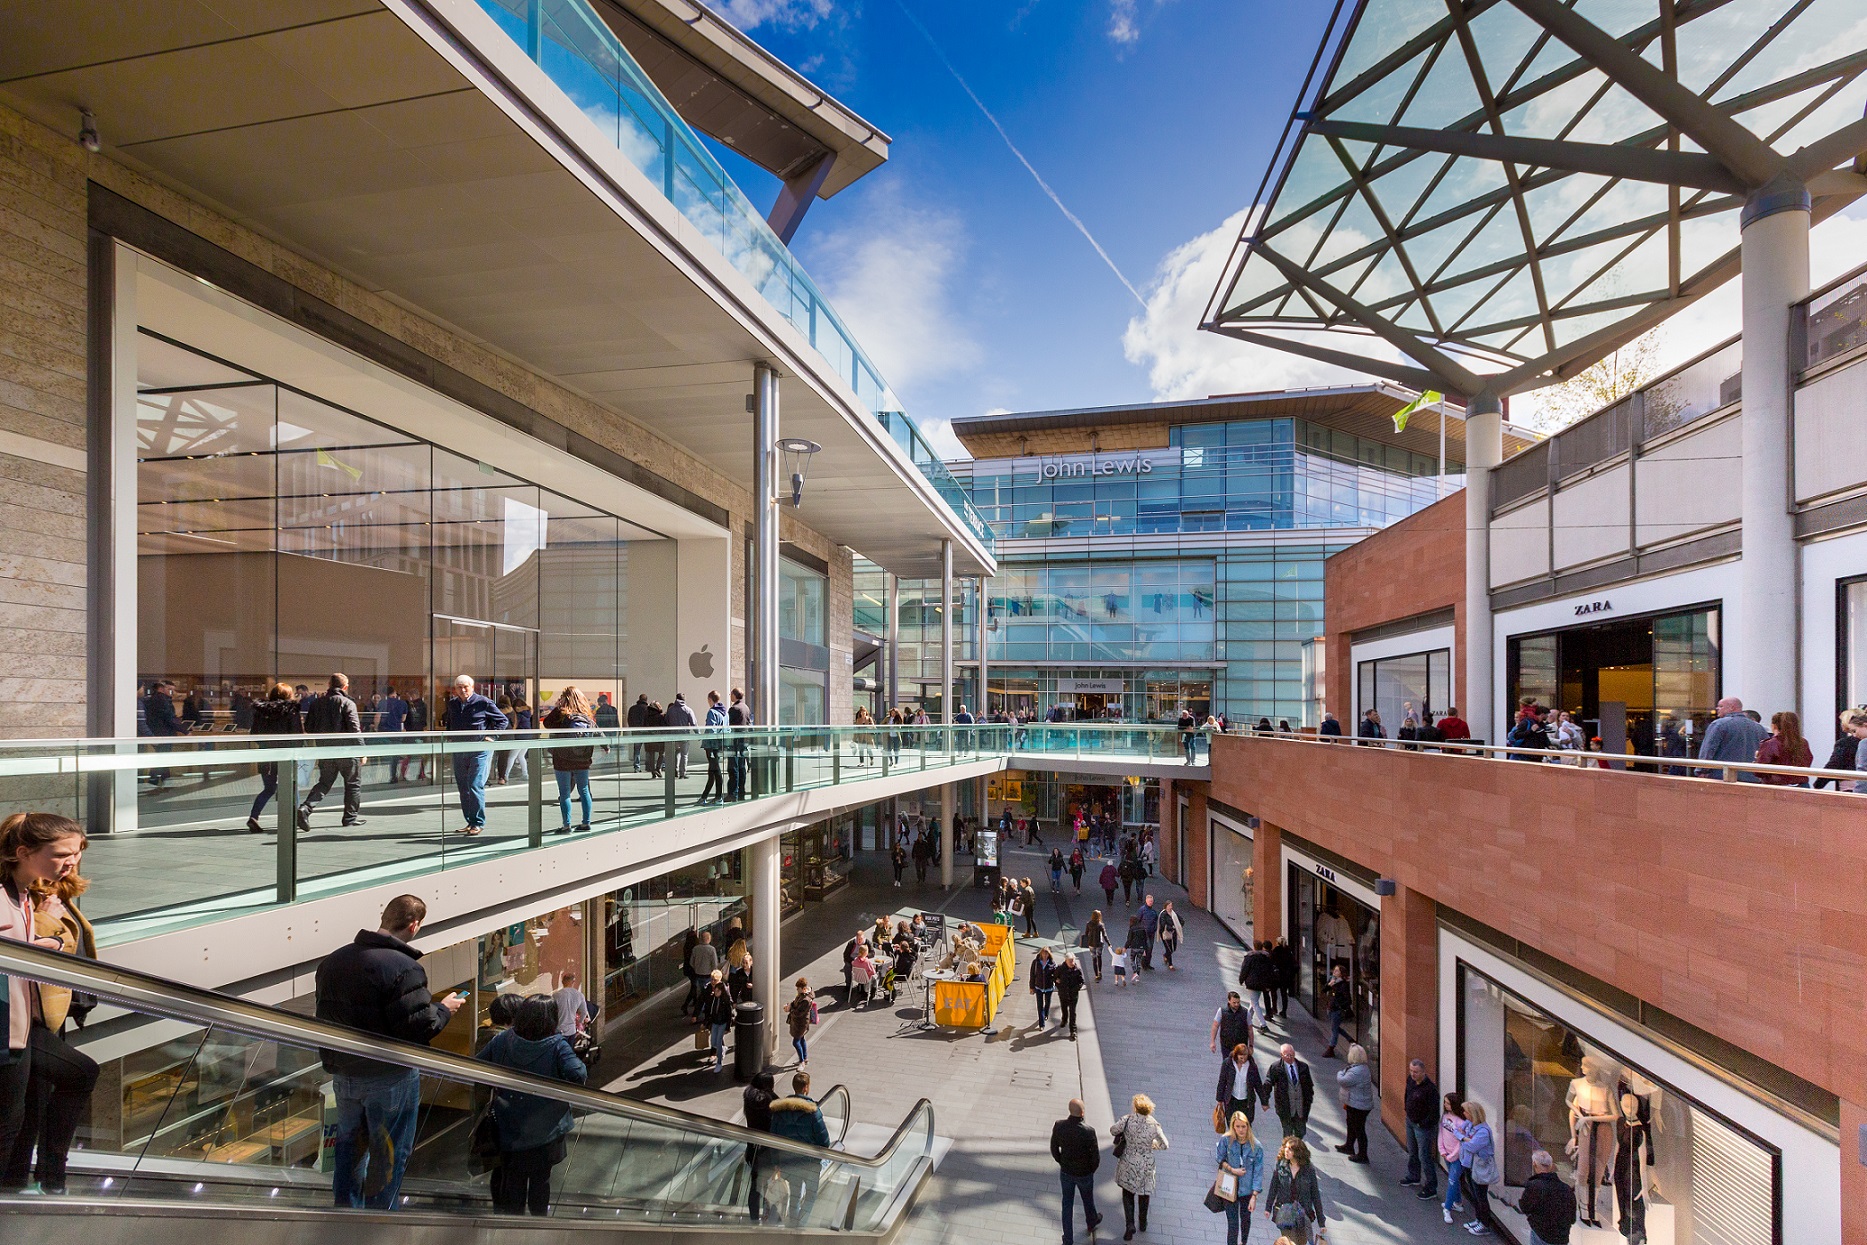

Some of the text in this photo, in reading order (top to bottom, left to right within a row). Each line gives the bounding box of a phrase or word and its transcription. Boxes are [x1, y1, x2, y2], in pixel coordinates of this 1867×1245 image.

[1036, 453, 1152, 484] John Lewis
[1574, 600, 1613, 616] ZARA
[1075, 682, 1089, 690] John
[1315, 864, 1336, 882] ZARA
